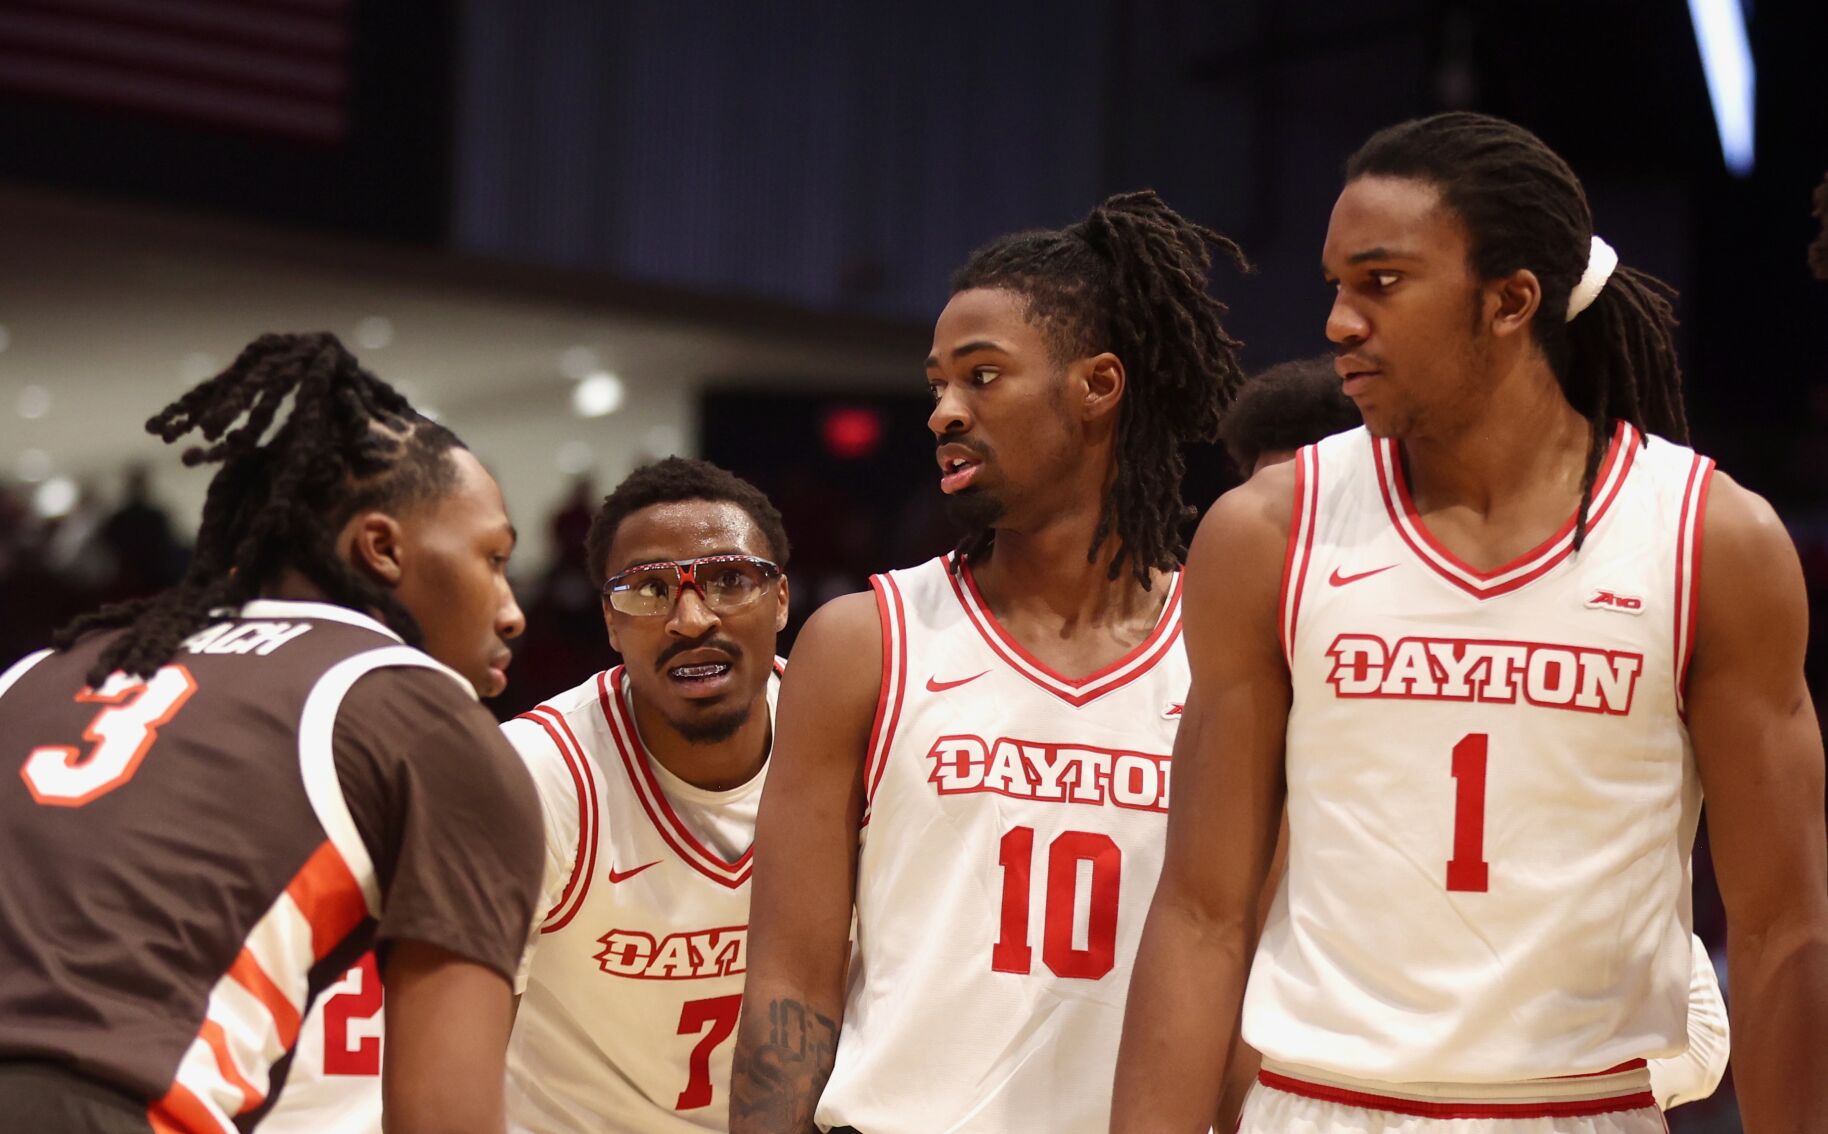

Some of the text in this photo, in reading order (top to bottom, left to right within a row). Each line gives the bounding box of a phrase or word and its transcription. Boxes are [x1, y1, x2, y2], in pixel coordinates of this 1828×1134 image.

[179, 621, 313, 655] ACH
[1326, 633, 1643, 716] DAYTON
[19, 662, 198, 808] 3
[926, 733, 1172, 814] DAYTO
[1446, 733, 1488, 892] 1
[592, 924, 748, 981] DAYT
[991, 825, 1122, 980] 10
[324, 950, 383, 1075] 2
[675, 993, 743, 1110] 7
